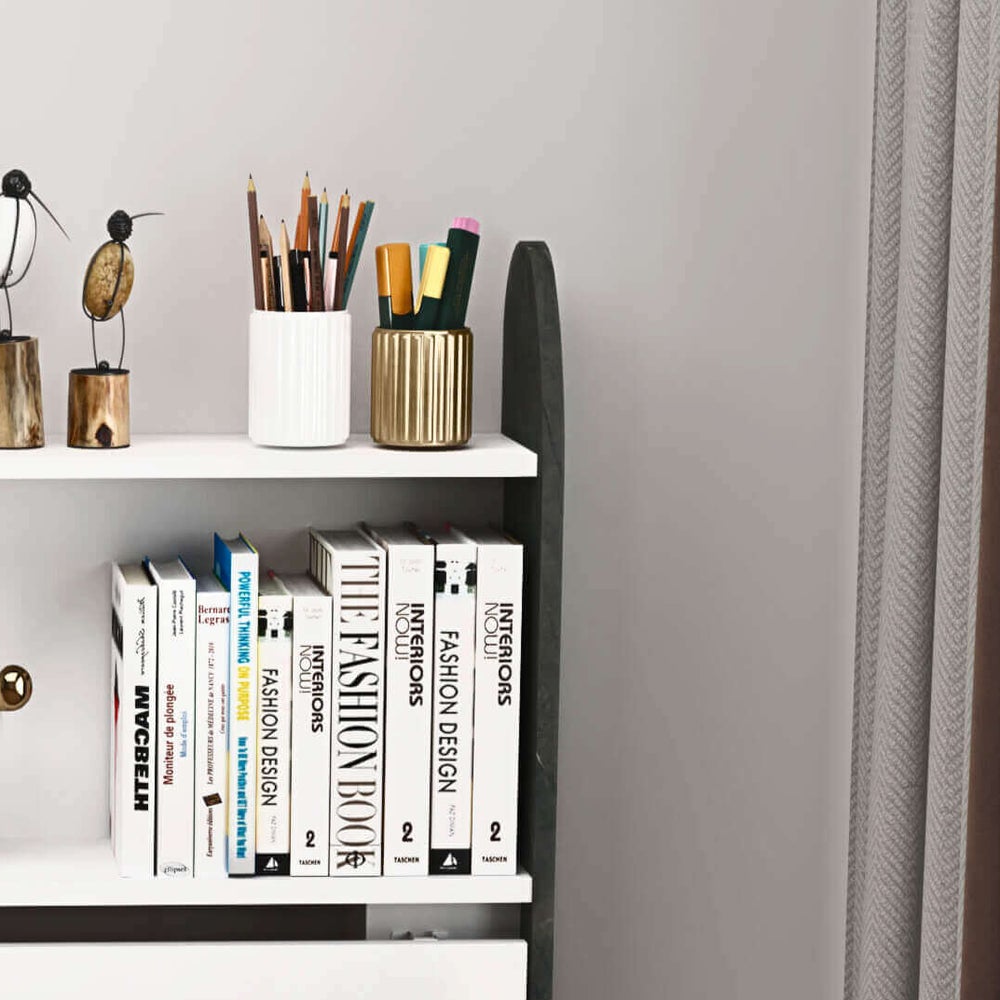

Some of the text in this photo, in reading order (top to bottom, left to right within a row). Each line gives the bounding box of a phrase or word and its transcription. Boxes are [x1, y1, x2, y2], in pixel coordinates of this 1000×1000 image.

[237, 571, 251, 721] POWERFUL THINKING ON PURPOSE
[311, 645, 323, 733] INTERIORS
[408, 603, 424, 707] INTERIORS
[497, 603, 514, 707] INTERIORS
[163, 684, 177, 785] Moniteur de plongée
[261, 668, 279, 806] FASHION DESIGN
[335, 556, 380, 869] THE FASHION BOOK
[438, 630, 459, 794] FASHION DESIGN
[306, 830, 316, 848] 2
[394, 856, 420, 864] TASCHEN
[402, 822, 414, 843] 2
[482, 855, 508, 863] TASCHEN
[490, 822, 502, 842] 2
